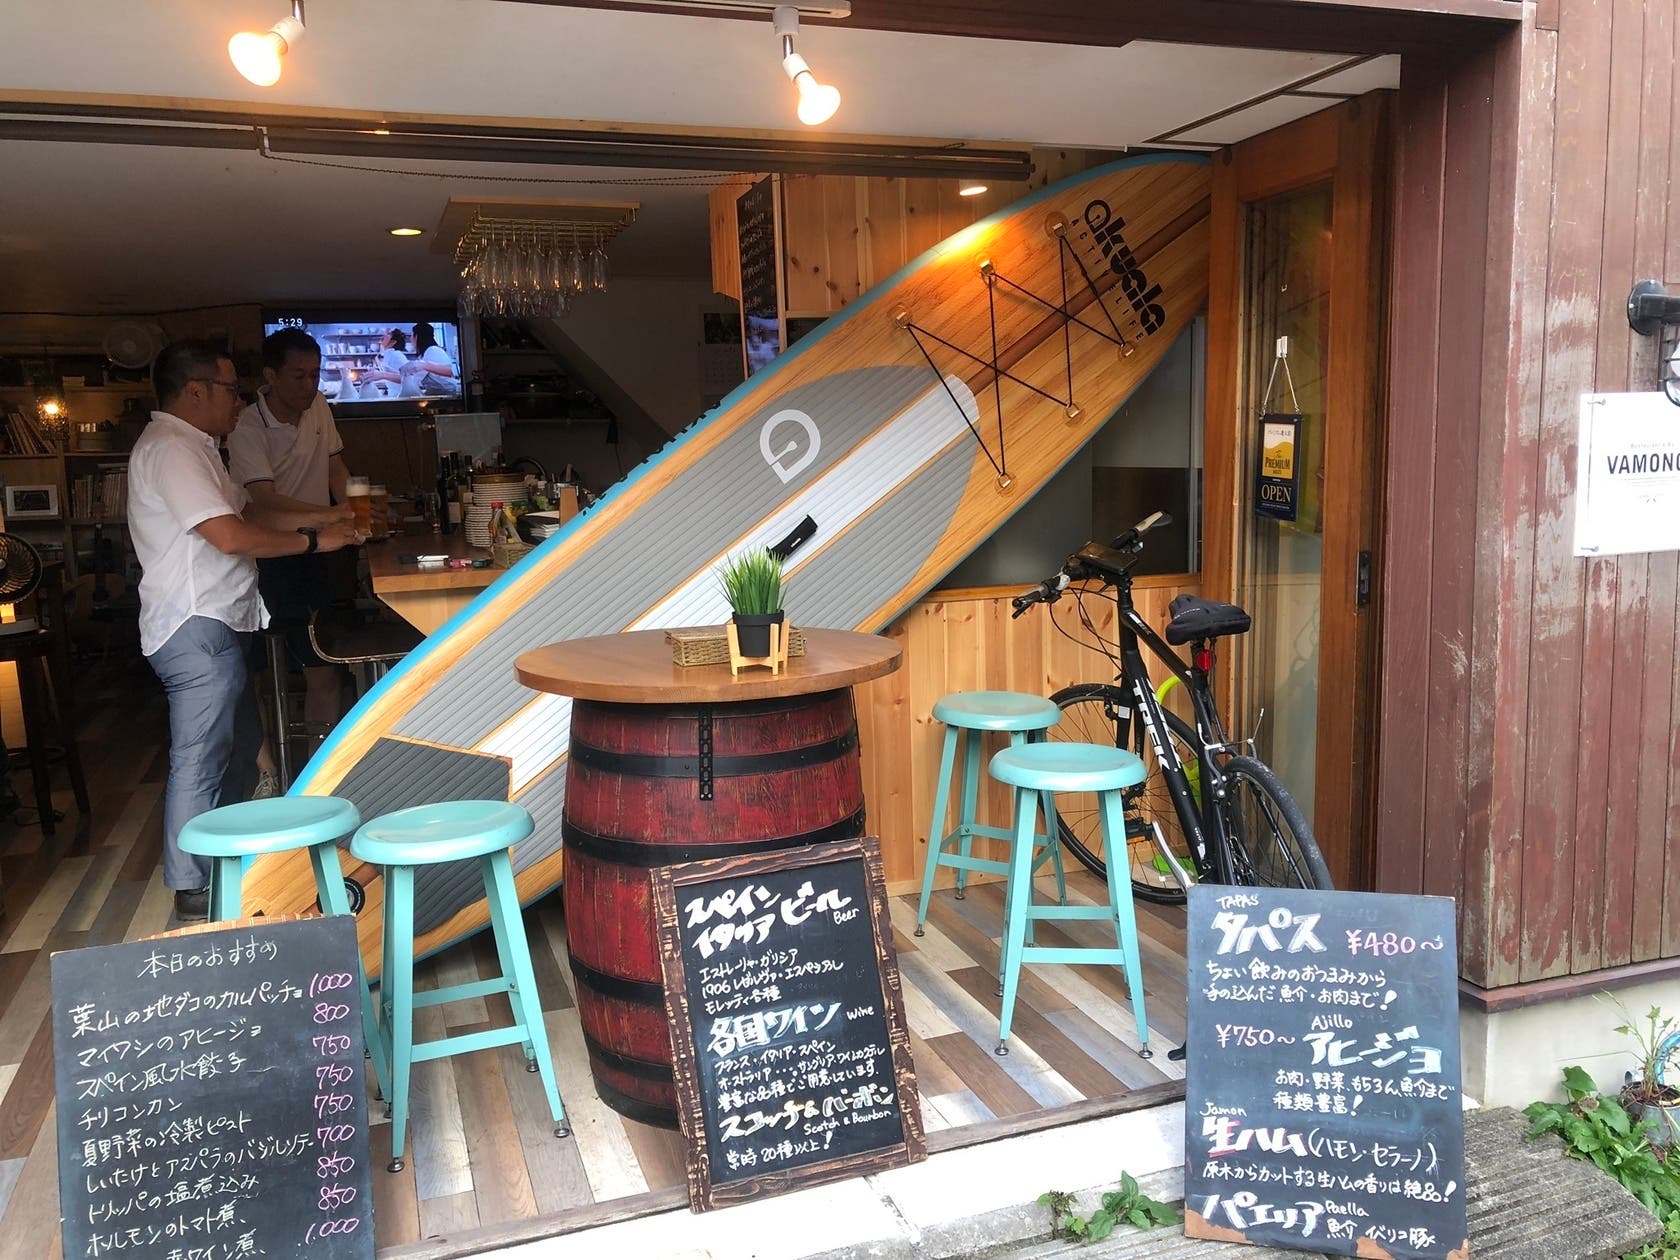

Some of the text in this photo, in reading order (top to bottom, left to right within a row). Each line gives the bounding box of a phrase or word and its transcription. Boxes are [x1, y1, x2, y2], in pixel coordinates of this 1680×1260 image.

[278, 318, 303, 327] 5:29
[1261, 484, 1292, 503] OPEN
[1132, 678, 1171, 770] TREK
[684, 884, 782, 929] スペイン
[779, 880, 853, 926] ビール
[832, 907, 860, 925] Beer
[1215, 895, 1260, 910] TAPAS
[1210, 907, 1327, 955] タパス
[137, 935, 278, 978] 本日のおすすめ
[1206, 956, 1387, 989] ちょい飲みのおつまみから
[702, 979, 731, 999] 1906
[704, 984, 783, 1016] モレッティ各種
[69, 979, 303, 1038] 葉山の地ダコのカルパッチョ
[846, 1005, 875, 1022] Wine
[1311, 1014, 1353, 1031] Ajillo
[76, 1003, 350, 1068] マイワシのアヒージョ 800
[1302, 1025, 1443, 1075] アヒージョ
[76, 1035, 351, 1100] スペイン風水餃子 750
[78, 1065, 354, 1130] チリコンカン 750
[1200, 1102, 1247, 1117] Jamon
[82, 1094, 353, 1168] 夏野菜の冷製ピスト 750
[317, 1125, 355, 1148] 700
[803, 1119, 840, 1136] Scotch
[852, 1109, 892, 1124] Bourbon
[1202, 1116, 1308, 1158] 生ハム
[88, 1152, 356, 1225] トリッパの塩煮込み 850
[317, 1187, 356, 1211] 850
[1201, 1191, 1369, 1238] パエリア Paella
[1327, 1219, 1436, 1249] 魚介 イベリコ豚
